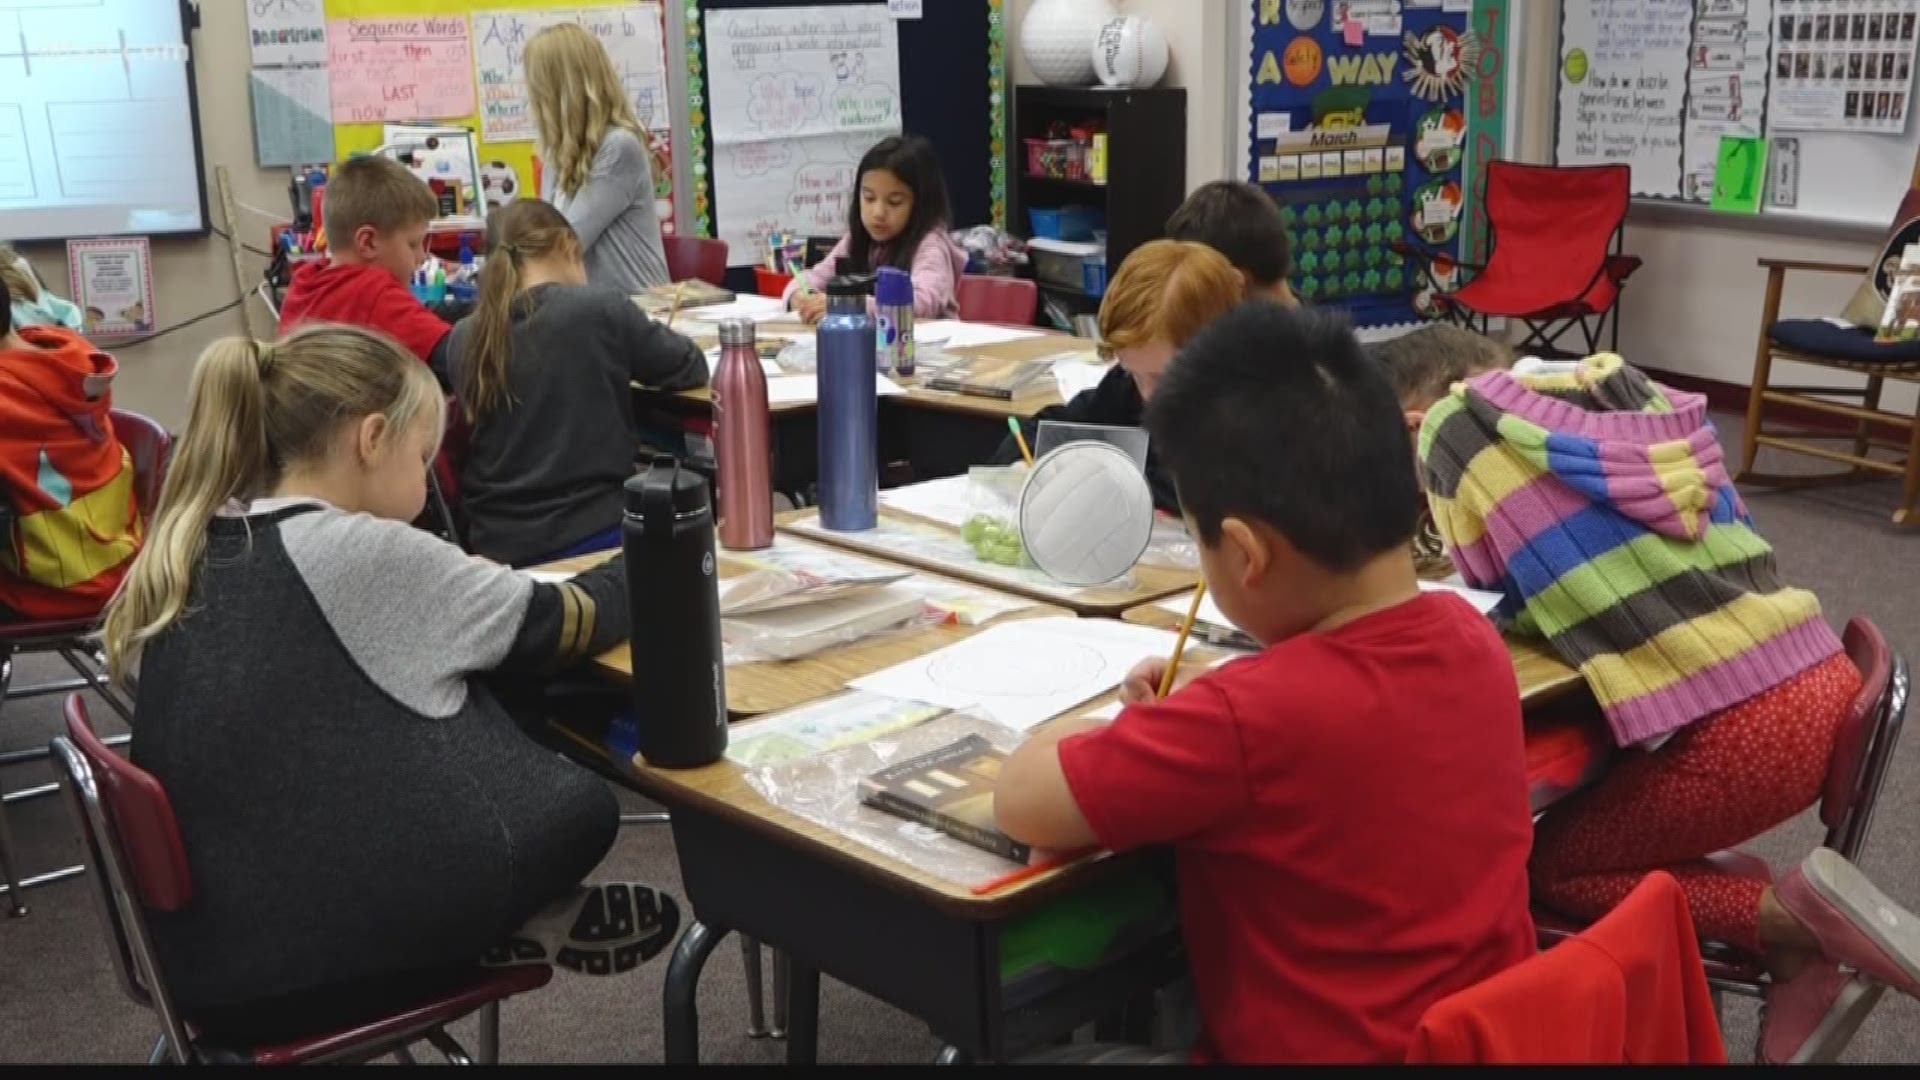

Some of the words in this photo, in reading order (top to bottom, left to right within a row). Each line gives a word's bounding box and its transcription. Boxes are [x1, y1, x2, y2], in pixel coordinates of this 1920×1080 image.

[348, 17, 419, 43] Sequence
[423, 16, 465, 36] Words
[403, 44, 432, 60] then
[1256, 50, 1282, 84] A
[1327, 52, 1398, 85] WAY
[382, 84, 418, 101] LAST
[351, 106, 386, 121] now
[1310, 132, 1357, 147] March
[793, 192, 823, 211] group
[825, 192, 842, 212] my
